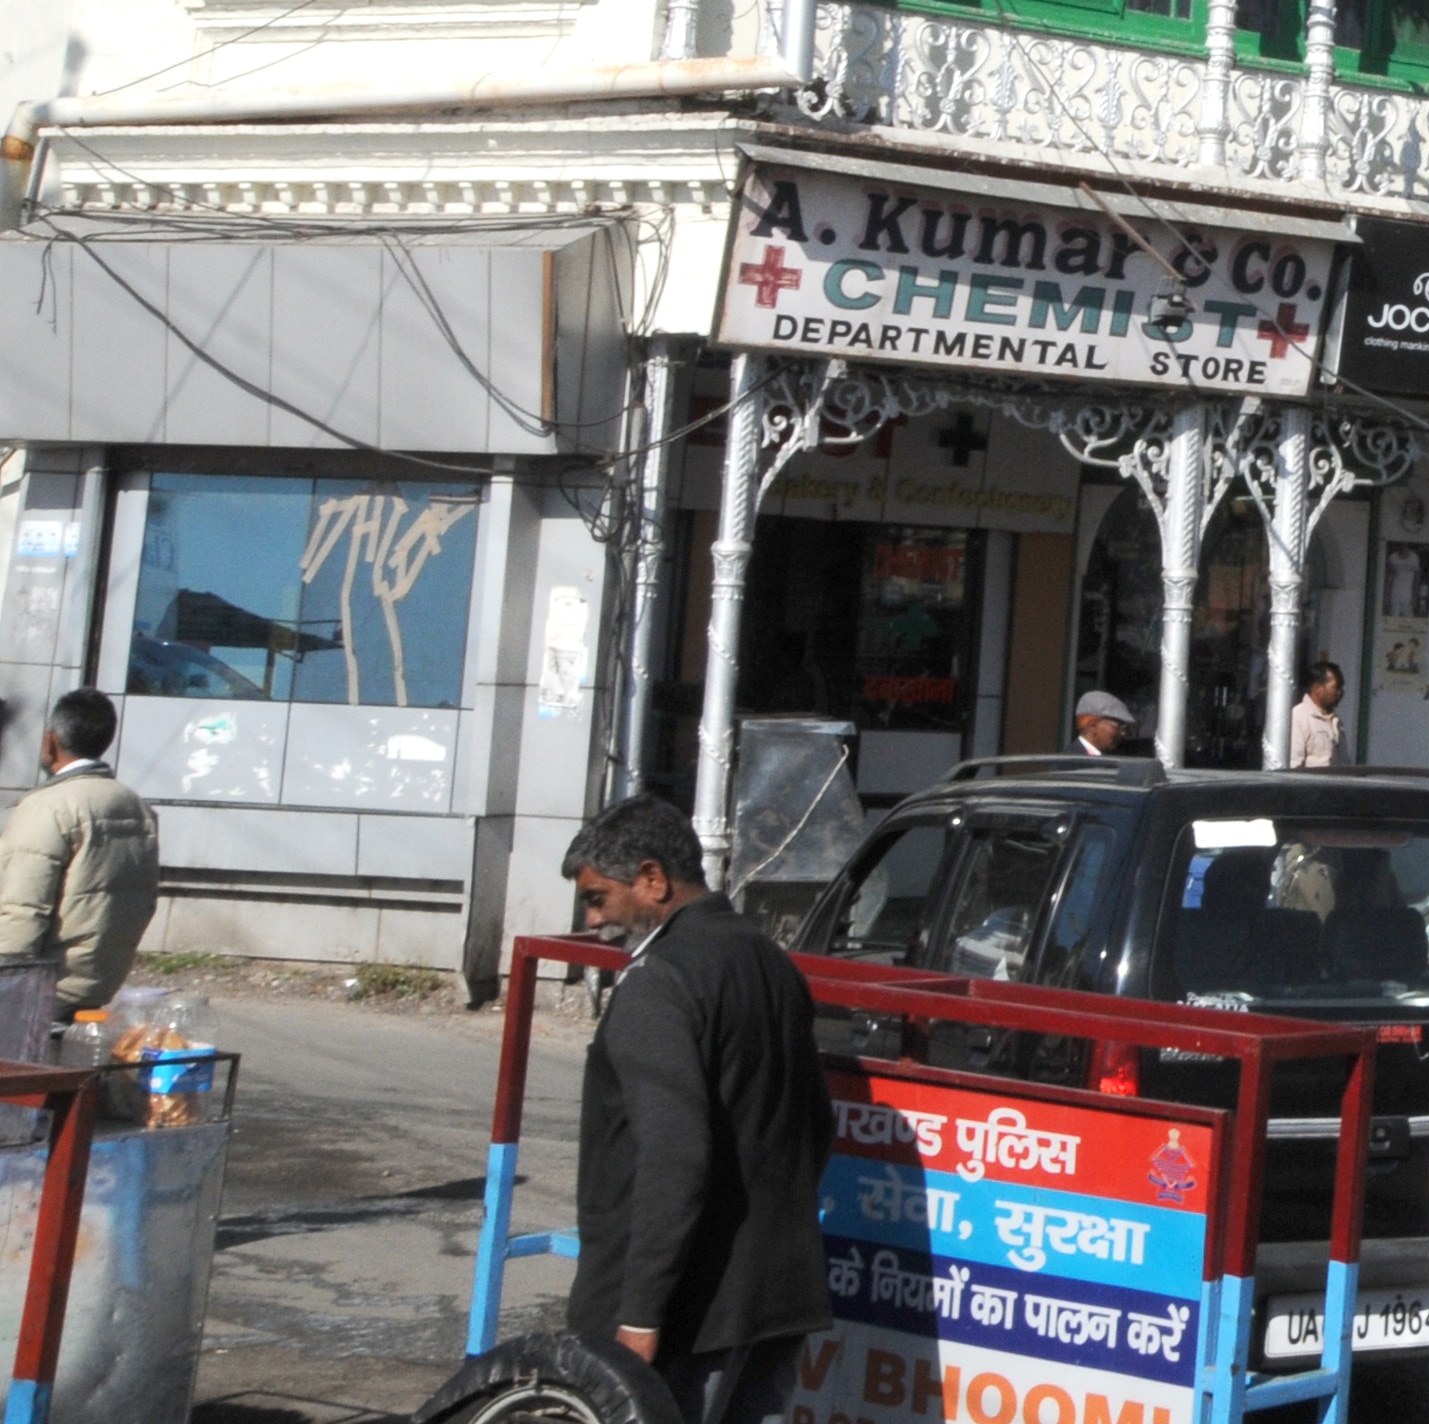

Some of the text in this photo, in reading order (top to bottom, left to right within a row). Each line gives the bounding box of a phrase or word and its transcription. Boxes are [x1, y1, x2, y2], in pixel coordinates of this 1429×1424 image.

[749, 180, 837, 246] A.
[860, 190, 1150, 280] Kumar
[1232, 239, 1324, 302] Co.
[771, 314, 1268, 385] DEPARTMENTAL STORE
[1364, 337, 1399, 351] clothing
[955, 1106, 1082, 1183] पुलिस
[993, 1198, 1152, 1273] सुरक्षा
[871, 1248, 971, 1320] नियमों
[969, 1282, 1018, 1331] का
[1024, 1292, 1122, 1348] पालन
[1126, 1302, 1191, 1363] करें
